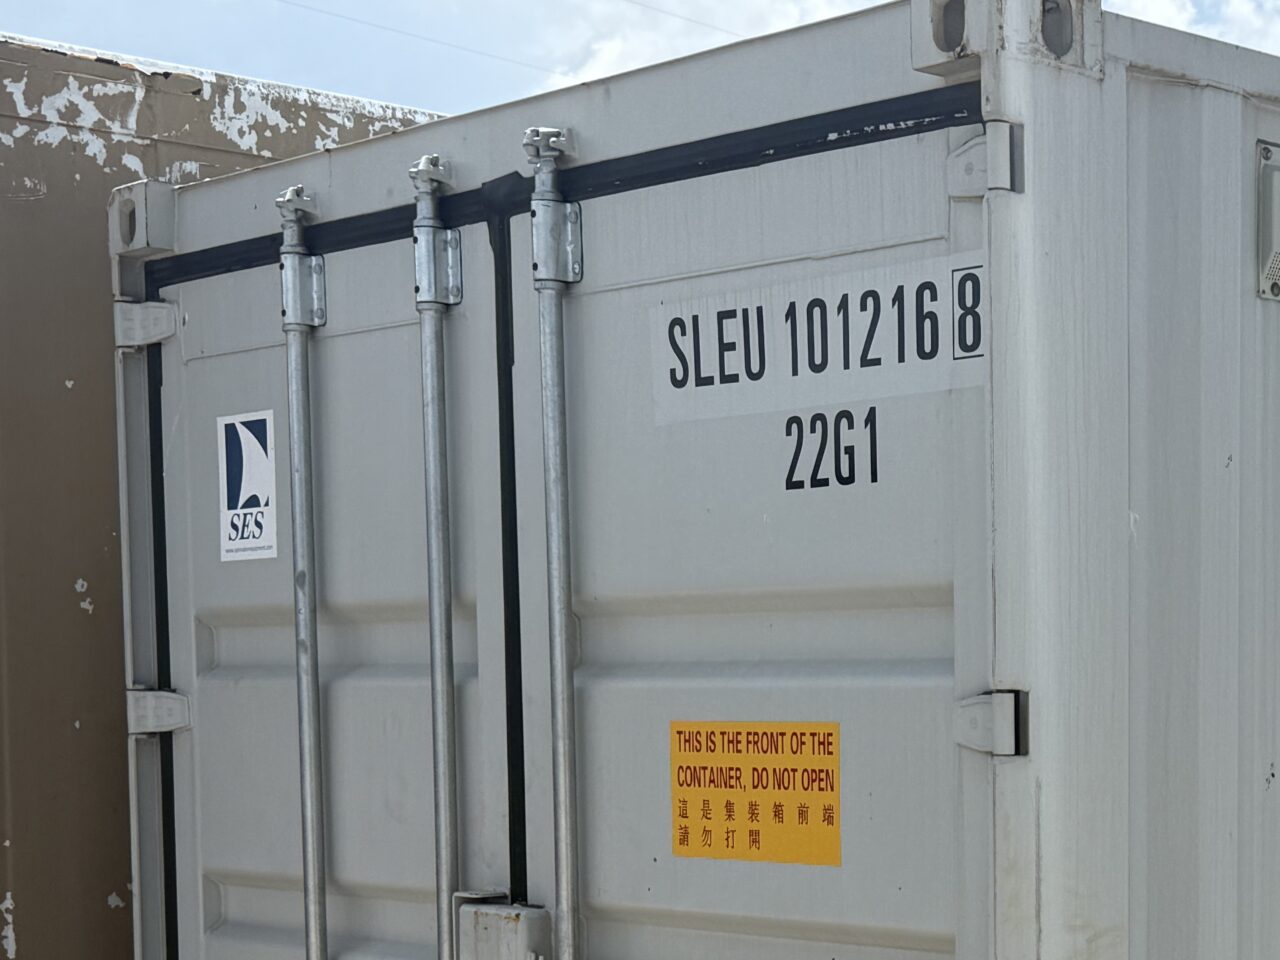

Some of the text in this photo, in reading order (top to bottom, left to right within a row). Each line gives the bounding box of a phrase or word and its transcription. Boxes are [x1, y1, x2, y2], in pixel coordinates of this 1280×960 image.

[668, 272, 982, 389] SLEU 101216 8
[785, 406, 878, 490] 22G1
[228, 510, 265, 542] SES
[676, 730, 834, 756] THIS IS THE FRONT OF THE
[677, 765, 835, 792] CONTAINER, DO NOT OPEN
[677, 798, 835, 826] 這是集裝箱前端
[677, 824, 761, 851] 請勿打開
